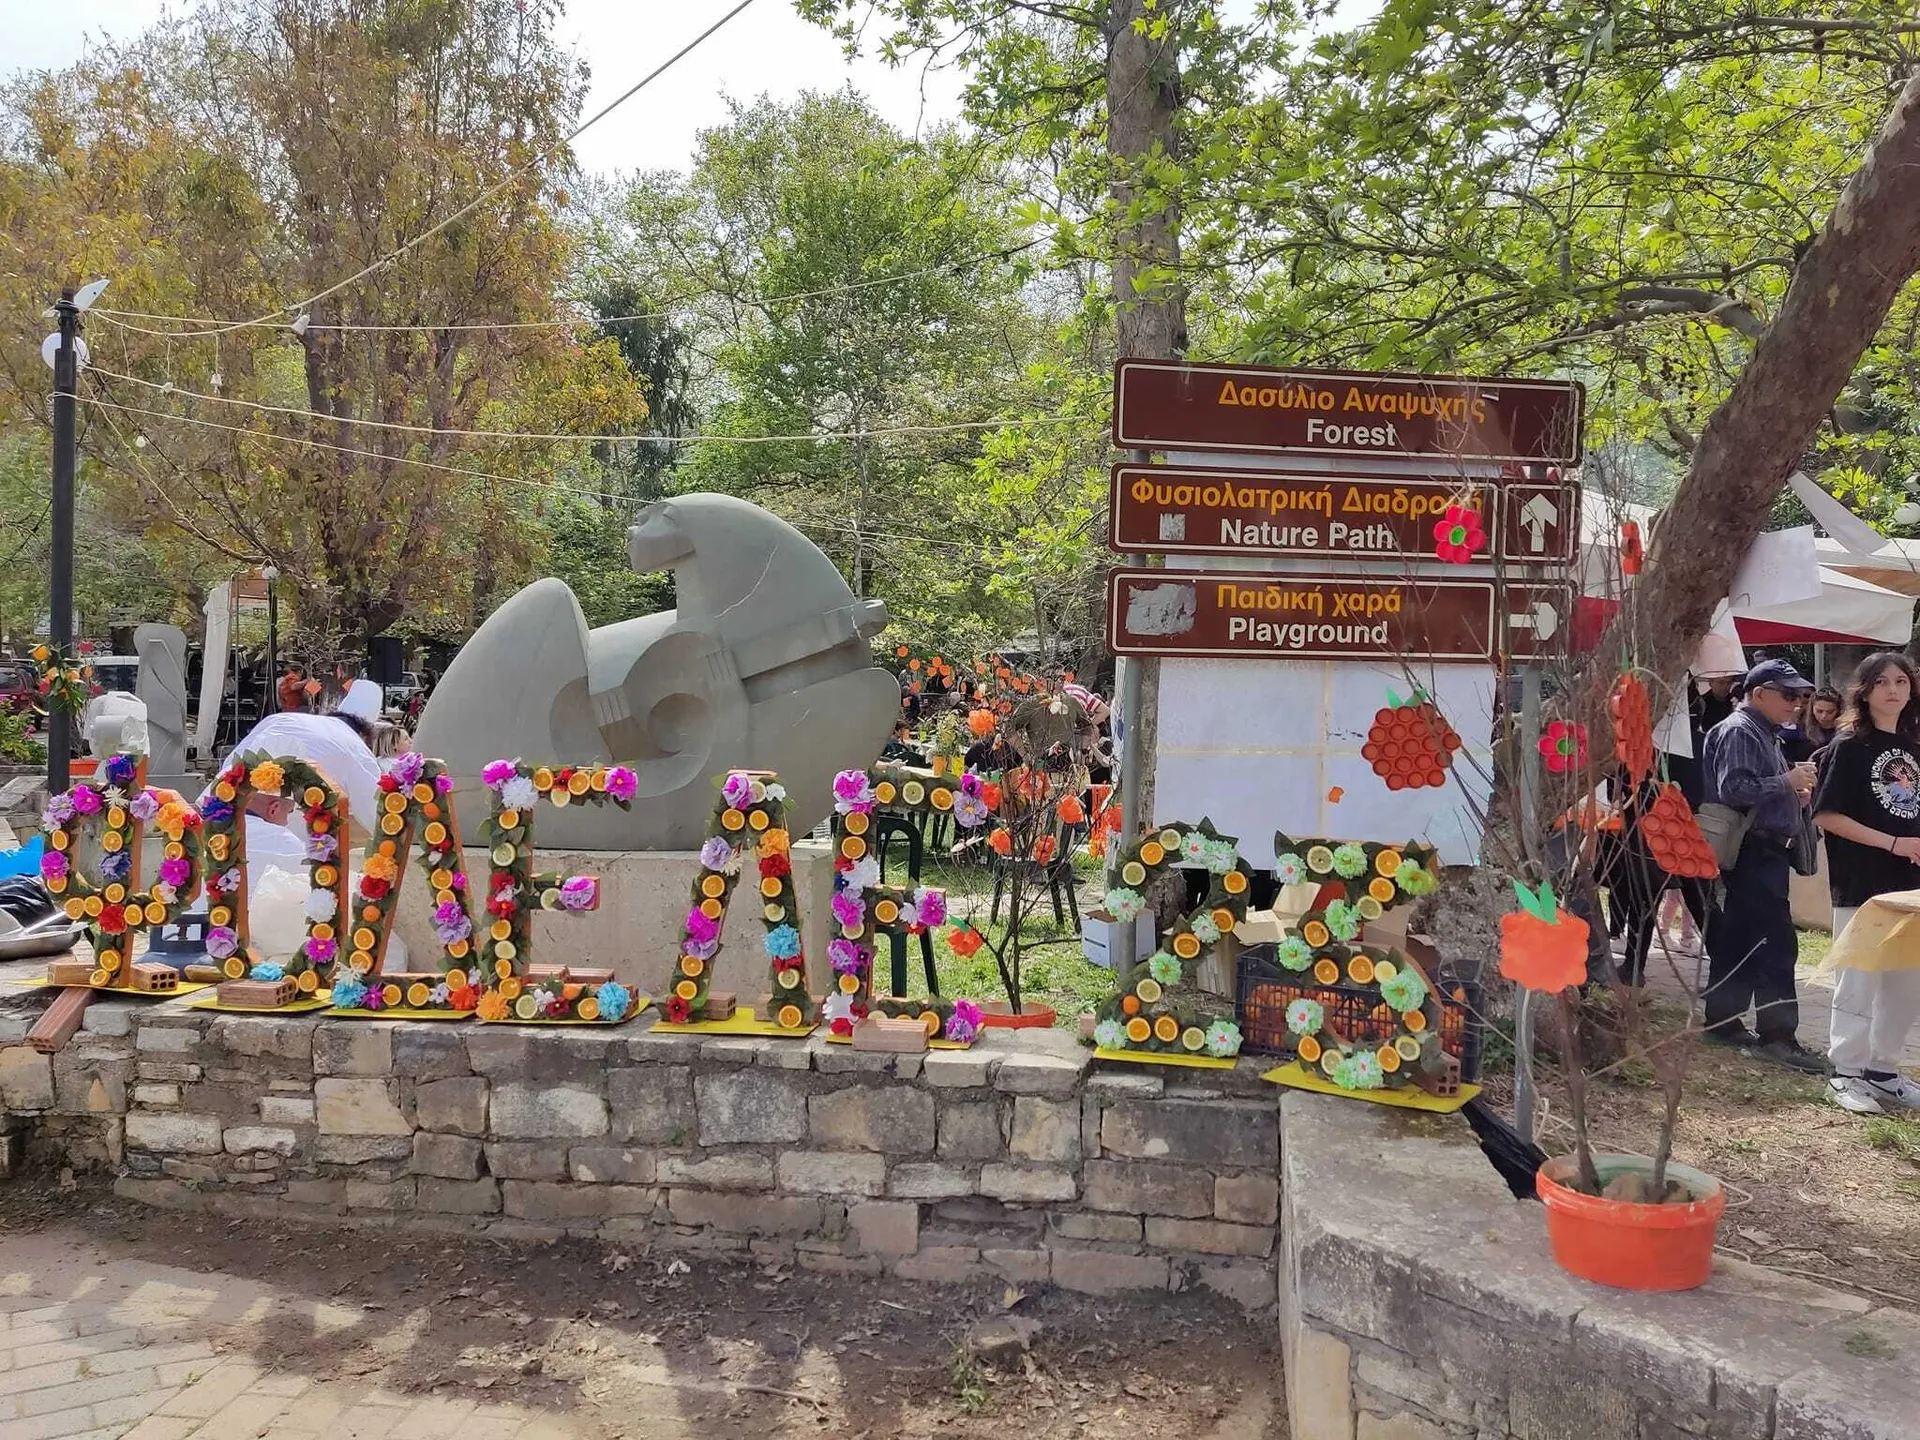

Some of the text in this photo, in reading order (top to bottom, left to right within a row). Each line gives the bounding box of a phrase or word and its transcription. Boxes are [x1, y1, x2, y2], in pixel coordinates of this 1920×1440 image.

[1306, 418, 1397, 447] Forest
[1131, 479, 1483, 520] Φυσιολατρική Διαδροή
[1220, 518, 1395, 549] Nature Path
[1217, 583, 1401, 618] Παιδική χαρά
[1228, 617, 1388, 647] Playground
[1870, 750, 1892, 779] WONDER
